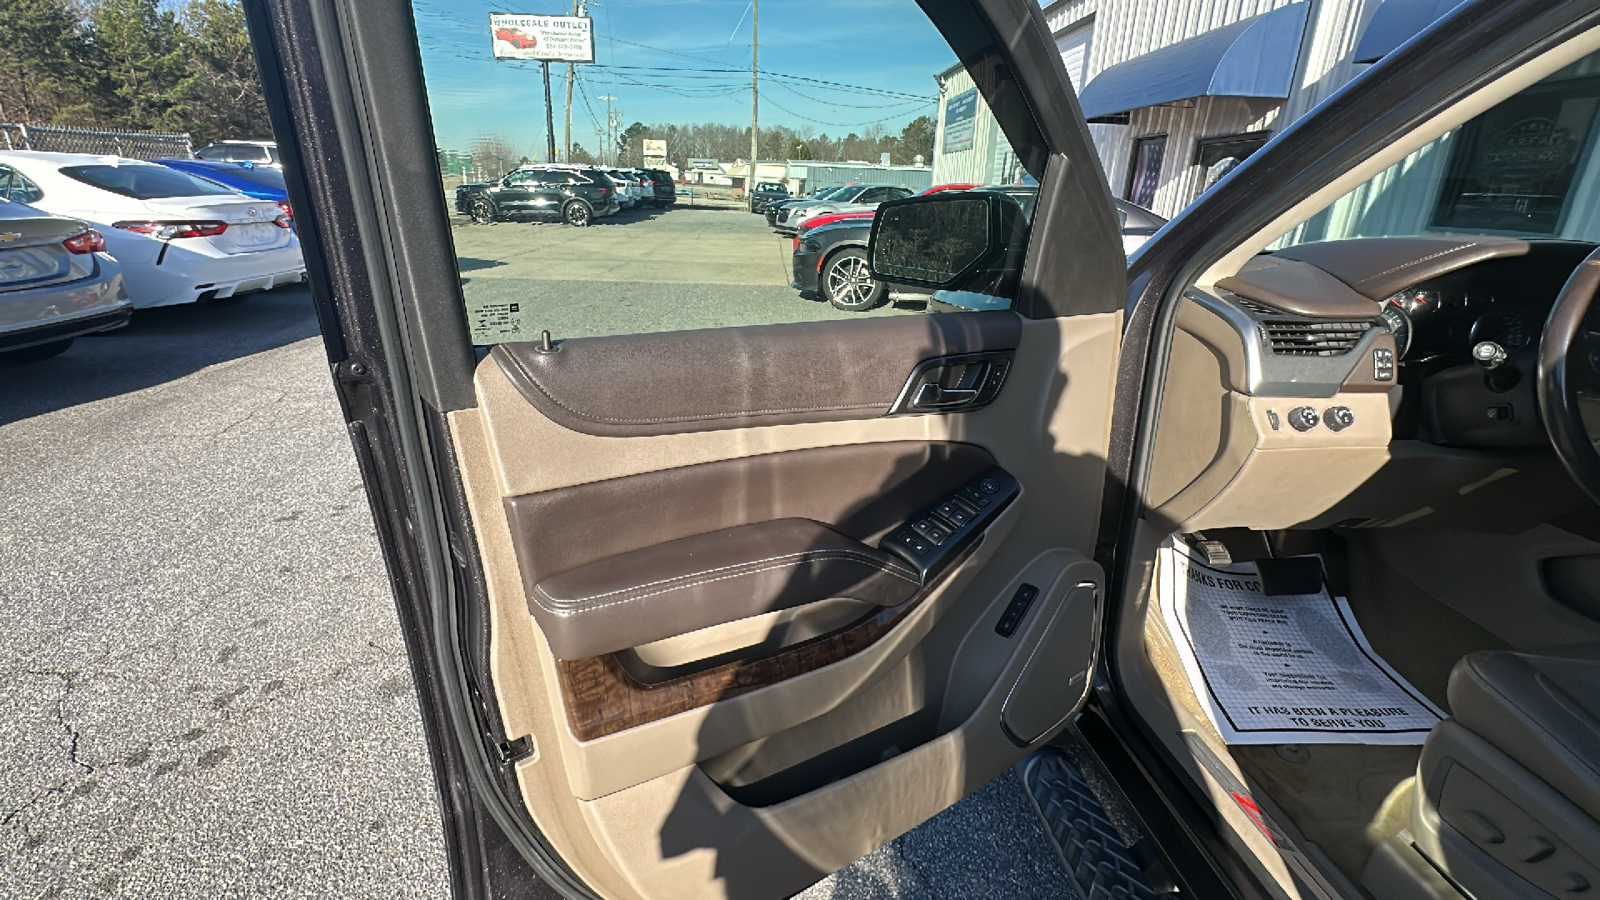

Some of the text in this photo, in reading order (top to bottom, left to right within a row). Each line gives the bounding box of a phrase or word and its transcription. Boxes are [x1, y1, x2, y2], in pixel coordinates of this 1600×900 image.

[493, 19, 588, 29] WHOLESALE OUTLET
[1180, 561, 1215, 587] THANKS
[1217, 578, 1244, 591] FOR
[1248, 706, 1409, 717] IT HAS BEEN A PLEASURE
[1290, 717, 1386, 728] TO SERVE YOU
